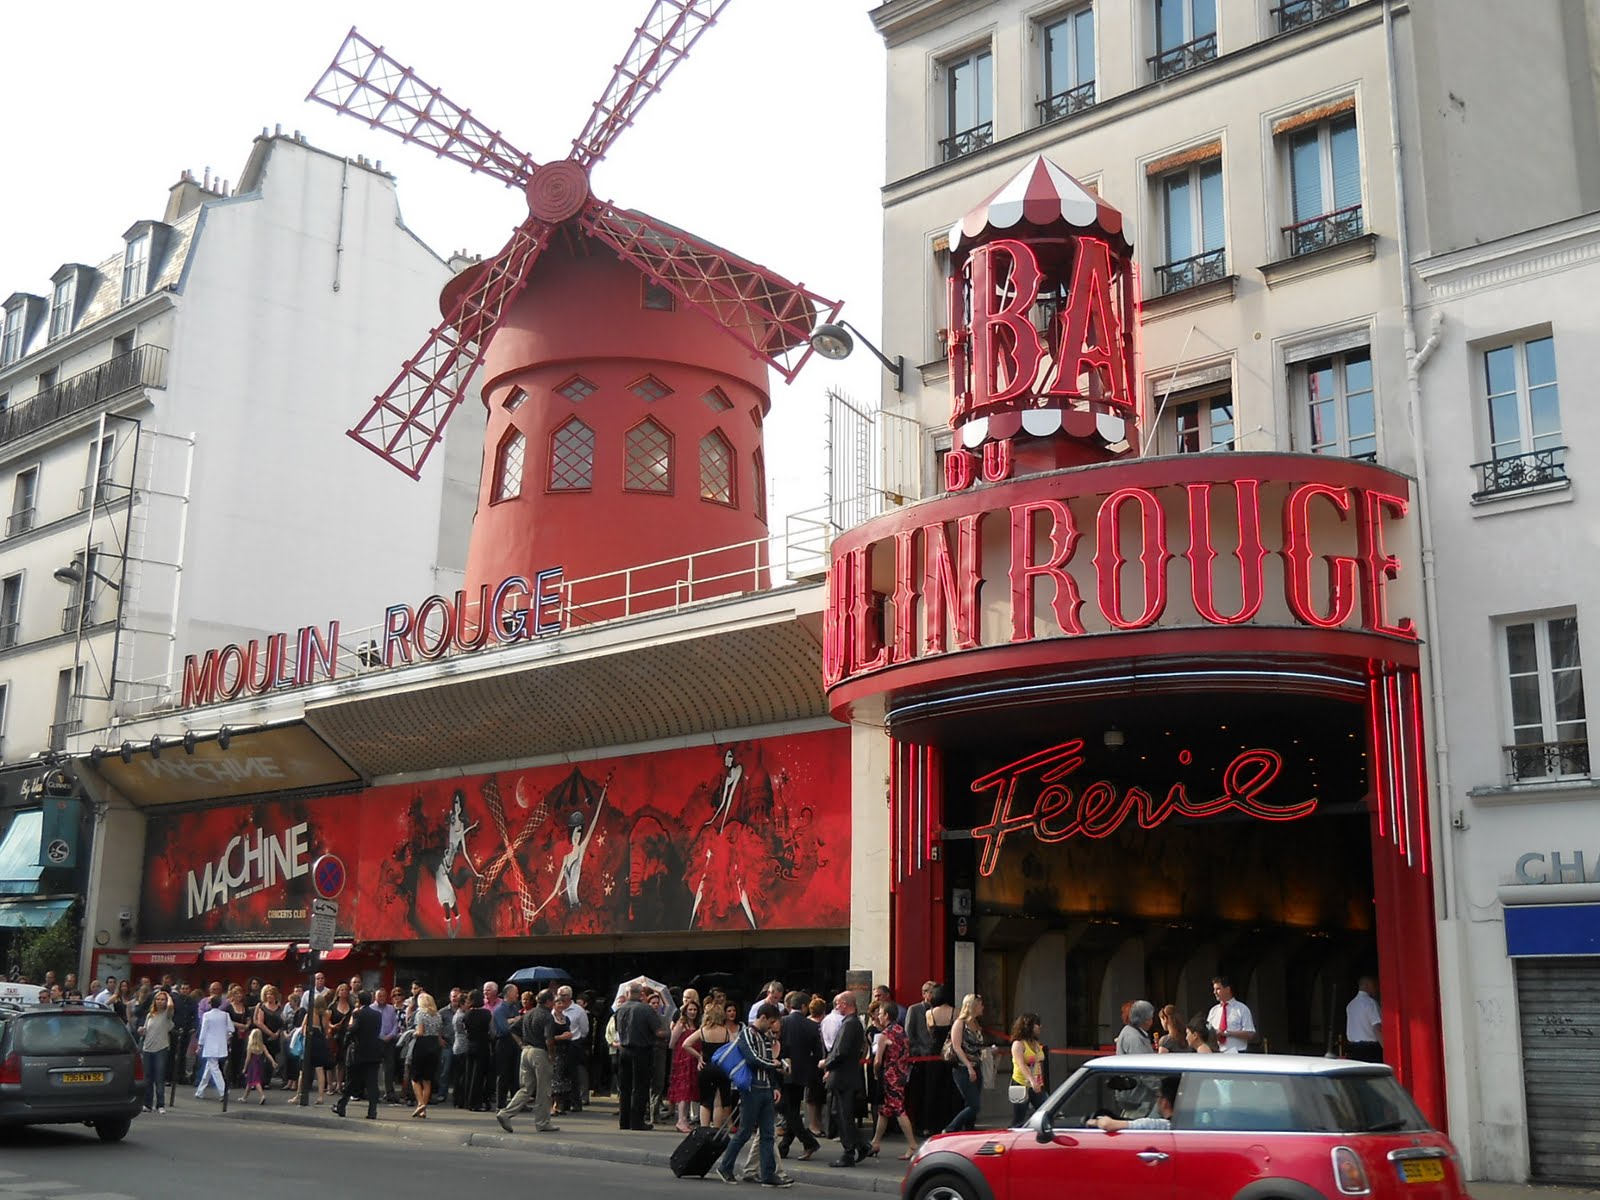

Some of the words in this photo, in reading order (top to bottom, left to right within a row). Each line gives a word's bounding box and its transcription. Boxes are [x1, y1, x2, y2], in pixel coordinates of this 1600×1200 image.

[943, 439, 1013, 492] DU
[1008, 478, 1419, 643] ROUGE
[181, 620, 340, 709] MOULIN
[382, 566, 565, 668] ROUGE
[971, 739, 1318, 877] Féerie
[187, 822, 309, 920] MACHINE
[1515, 850, 1600, 885] CH
